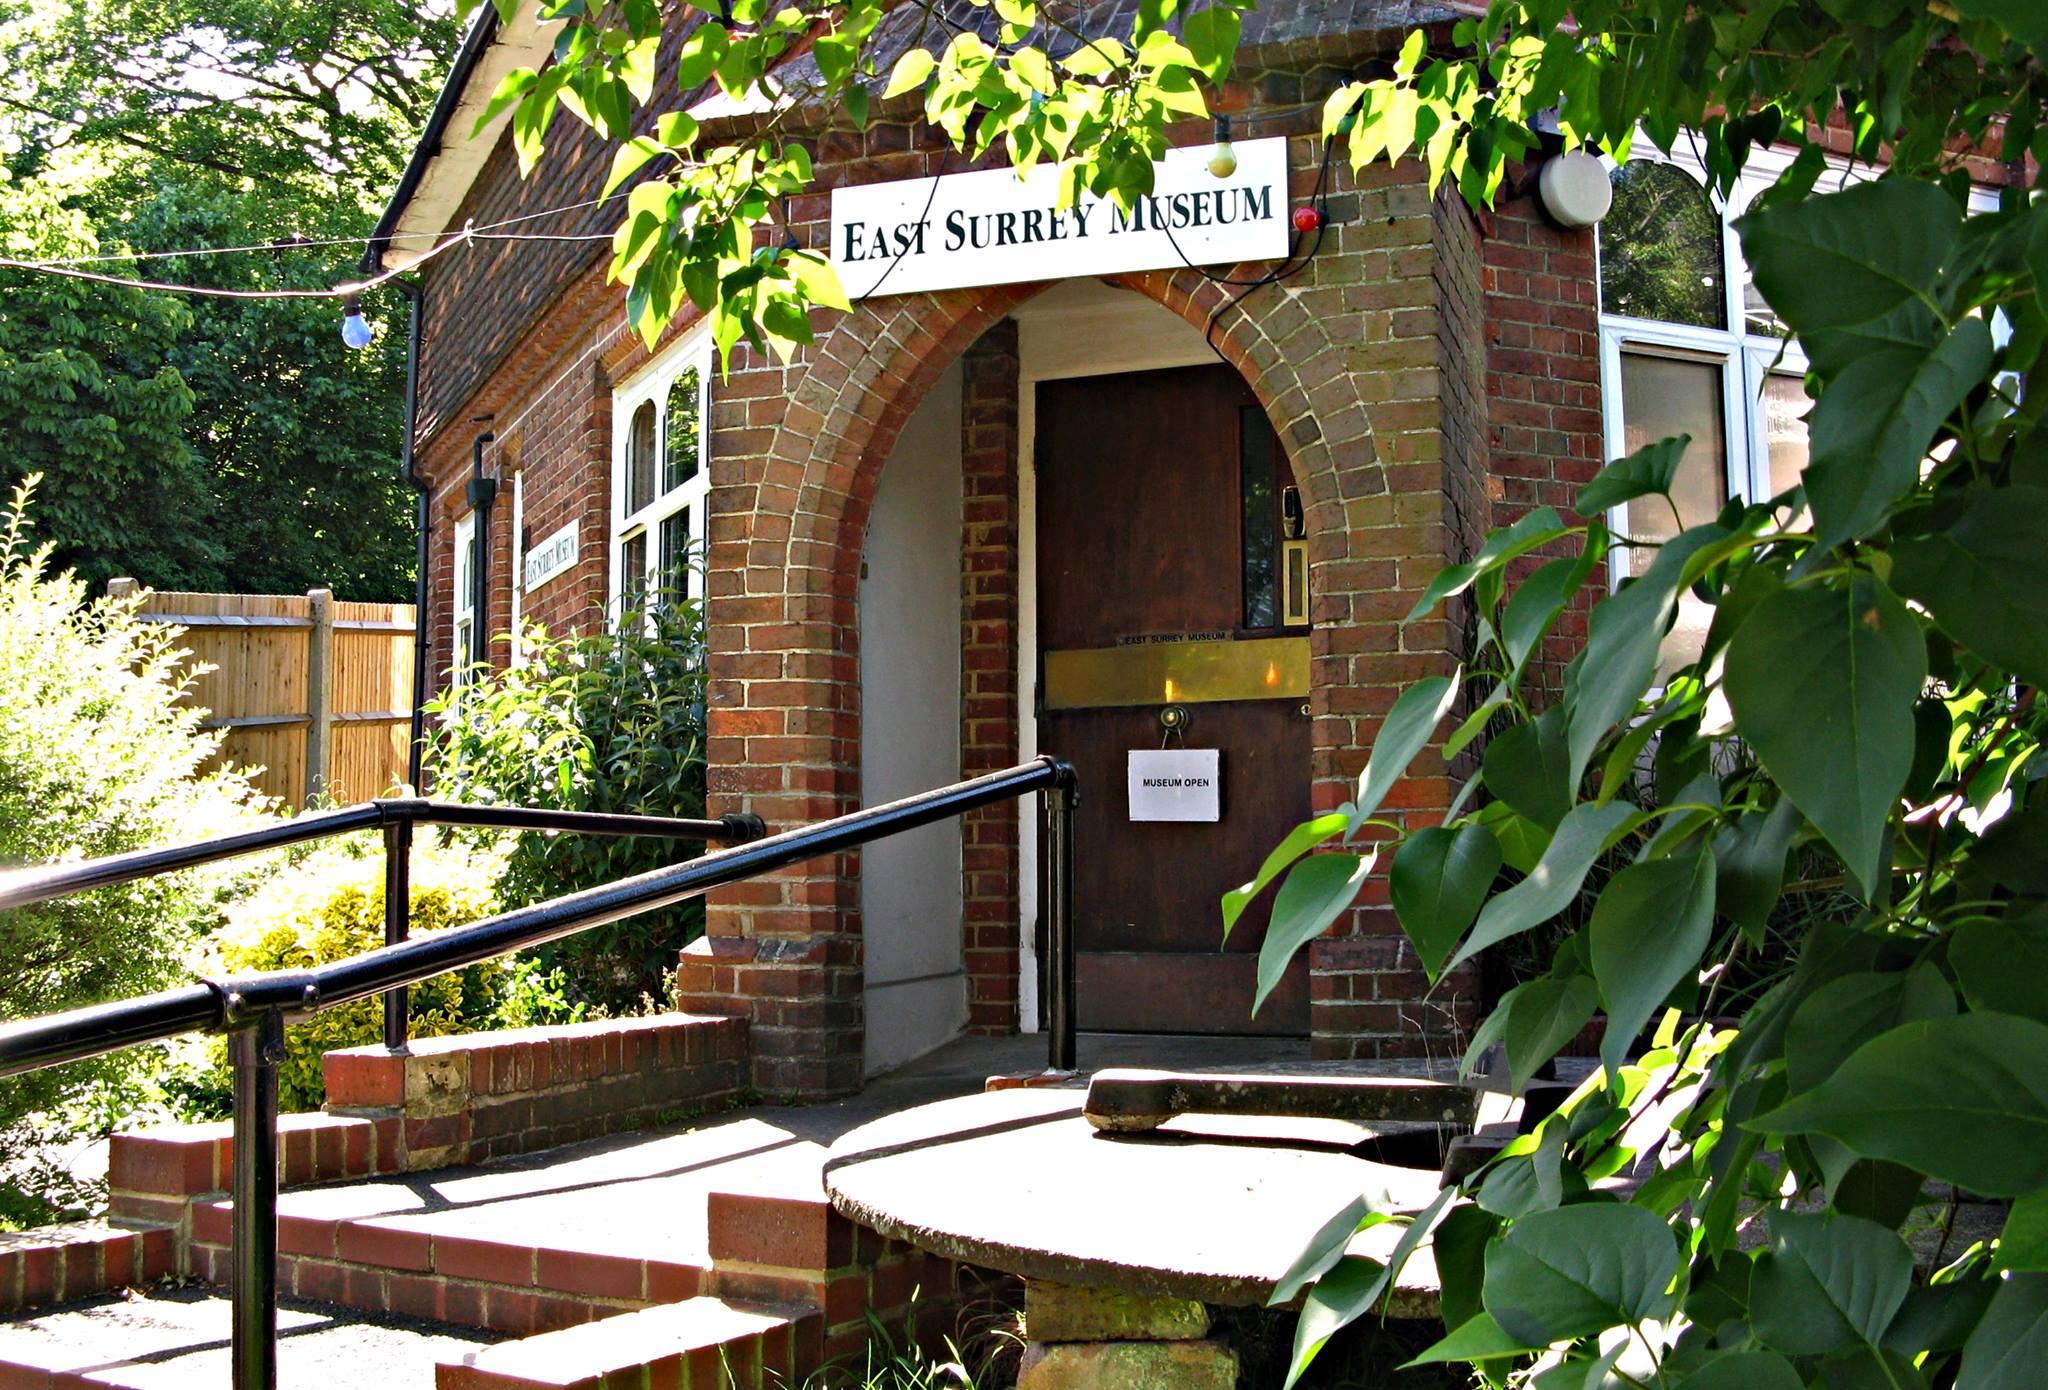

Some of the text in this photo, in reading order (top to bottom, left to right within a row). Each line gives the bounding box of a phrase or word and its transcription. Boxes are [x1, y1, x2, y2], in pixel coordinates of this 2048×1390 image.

[842, 185, 1273, 262] EAST SURREY MUSEUM
[1126, 631, 1226, 645] EAST SURREY MUSEUM
[1142, 778, 1209, 787] MUSEUM OPEN
